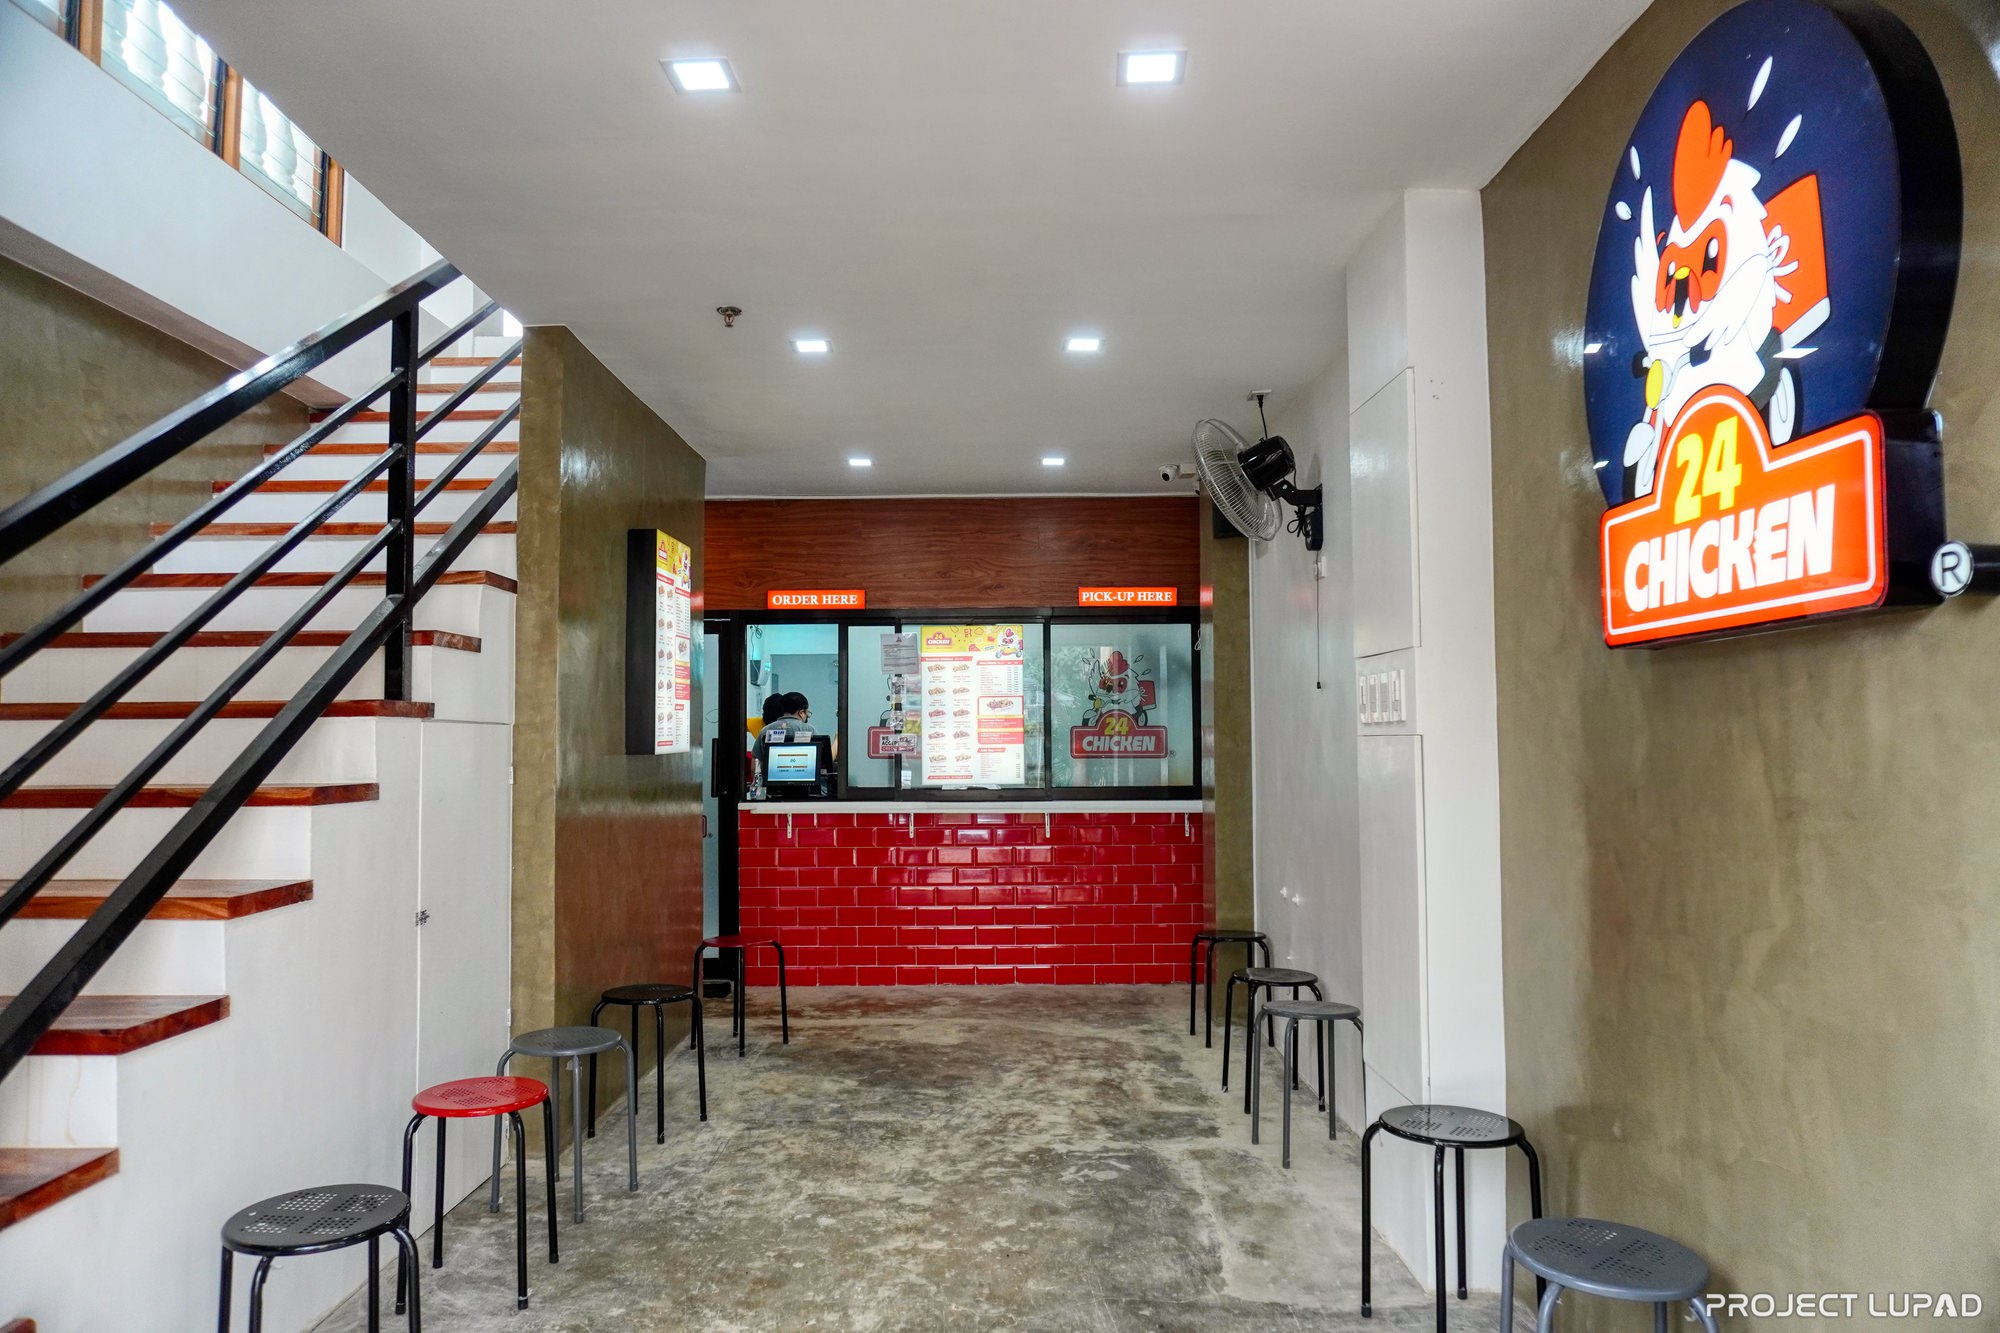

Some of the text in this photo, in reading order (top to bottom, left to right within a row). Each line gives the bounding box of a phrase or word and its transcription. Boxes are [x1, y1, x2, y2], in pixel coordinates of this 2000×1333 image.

[1674, 415, 1742, 525] 24
[1623, 483, 1836, 613] CHICKEN
[772, 594, 858, 605] ORDER HERE
[1081, 591, 1173, 602] PICK-UP HERE
[1104, 717, 1129, 736] 24
[1082, 736, 1156, 752] CHICKEN
